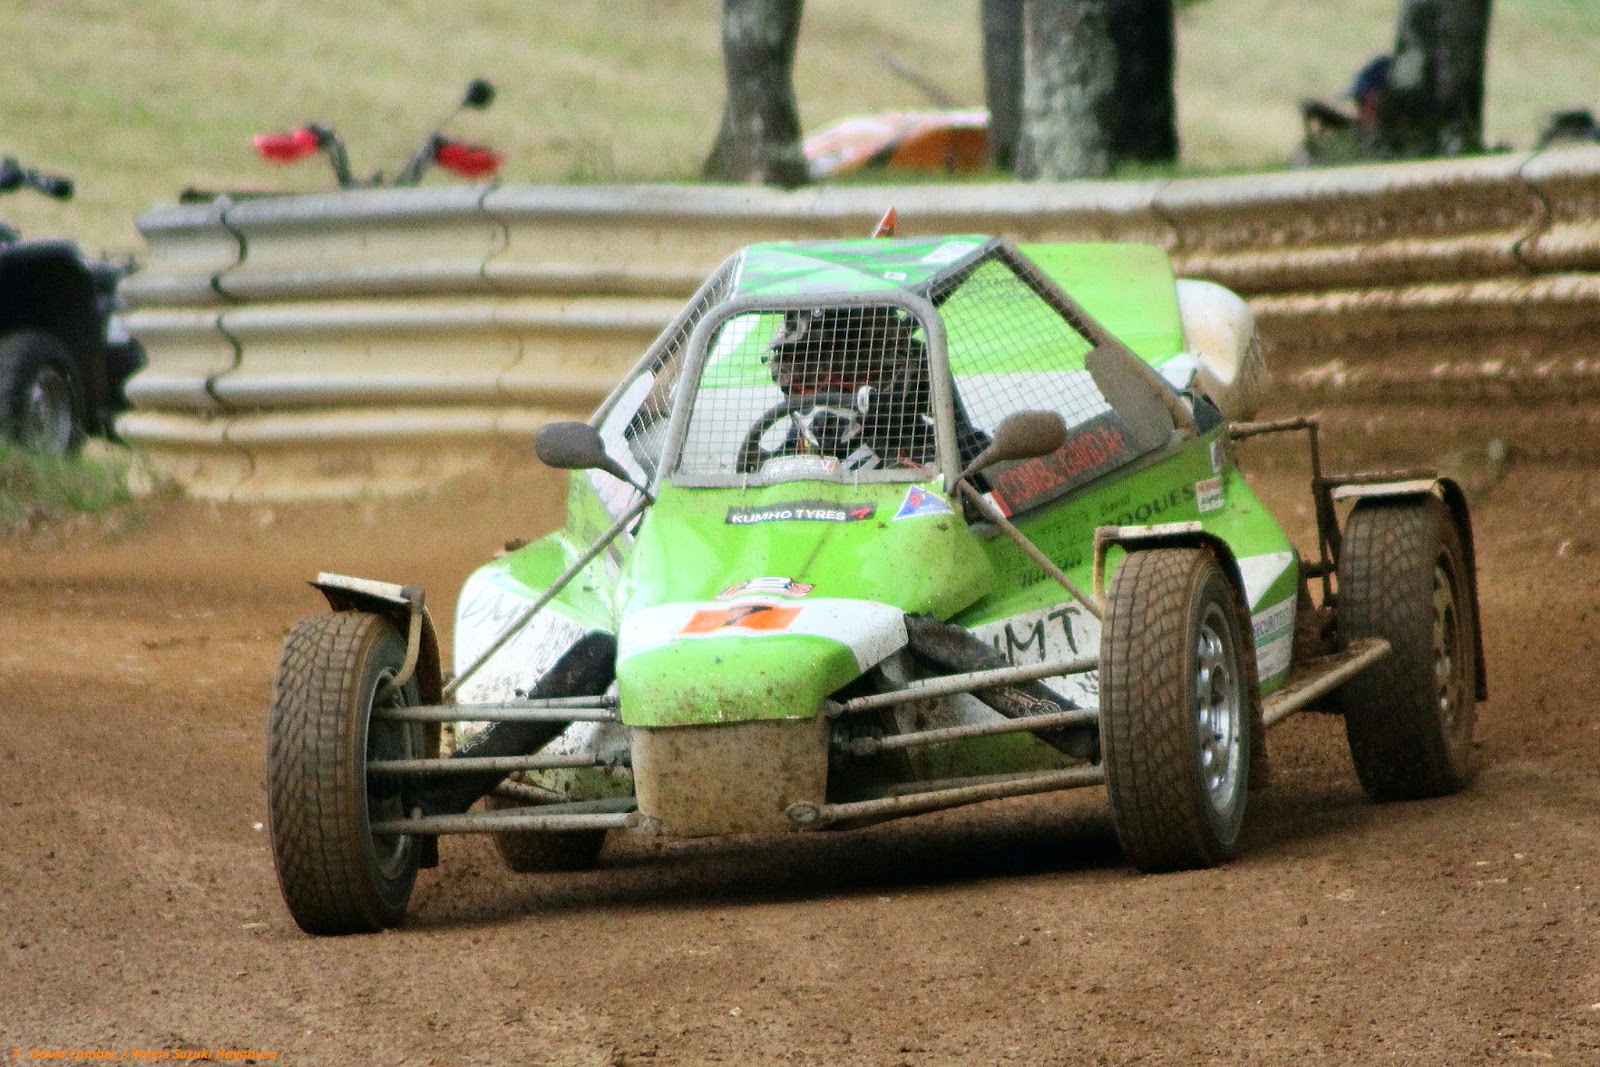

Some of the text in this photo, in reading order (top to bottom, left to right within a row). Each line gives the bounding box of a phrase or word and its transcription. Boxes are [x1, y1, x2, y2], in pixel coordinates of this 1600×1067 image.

[731, 509, 847, 525] KUMHO TYRES
[722, 604, 774, 627] 7
